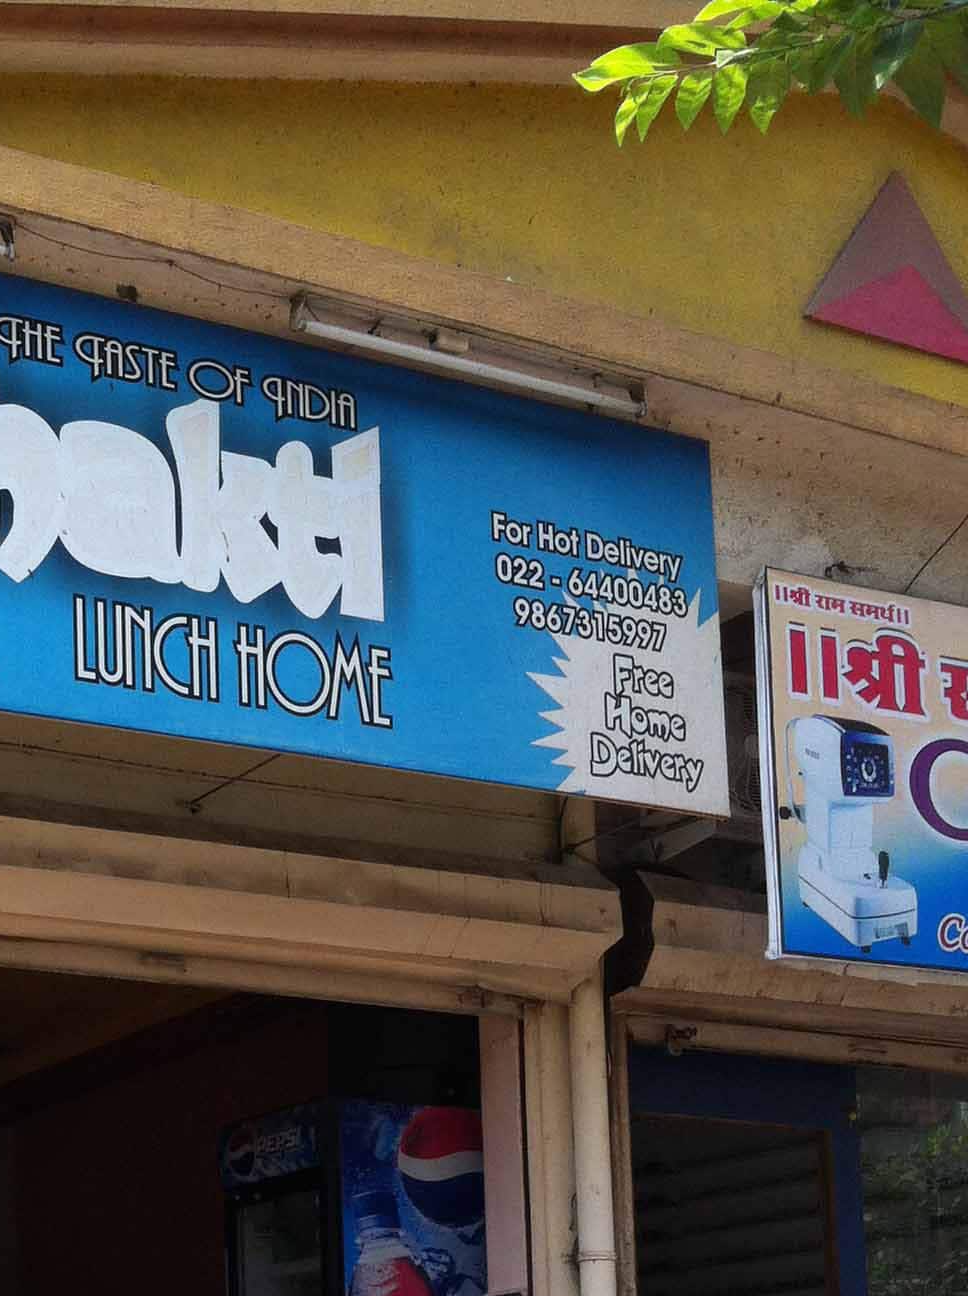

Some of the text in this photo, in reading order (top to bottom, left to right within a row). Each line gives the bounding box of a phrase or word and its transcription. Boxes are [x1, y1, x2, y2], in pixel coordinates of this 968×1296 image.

[73, 332, 176, 391] TASTE
[187, 359, 251, 405] OF
[261, 374, 357, 431] INDIA
[491, 509, 683, 582] For Hot Delivery
[495, 552, 545, 590] 022
[567, 567, 688, 618] 64400483
[512, 596, 667, 652] 9867315997
[72, 593, 393, 729] LUNCH HOME
[612, 653, 674, 699] Free
[604, 692, 686, 741] Home
[590, 732, 704, 793] Delivery
